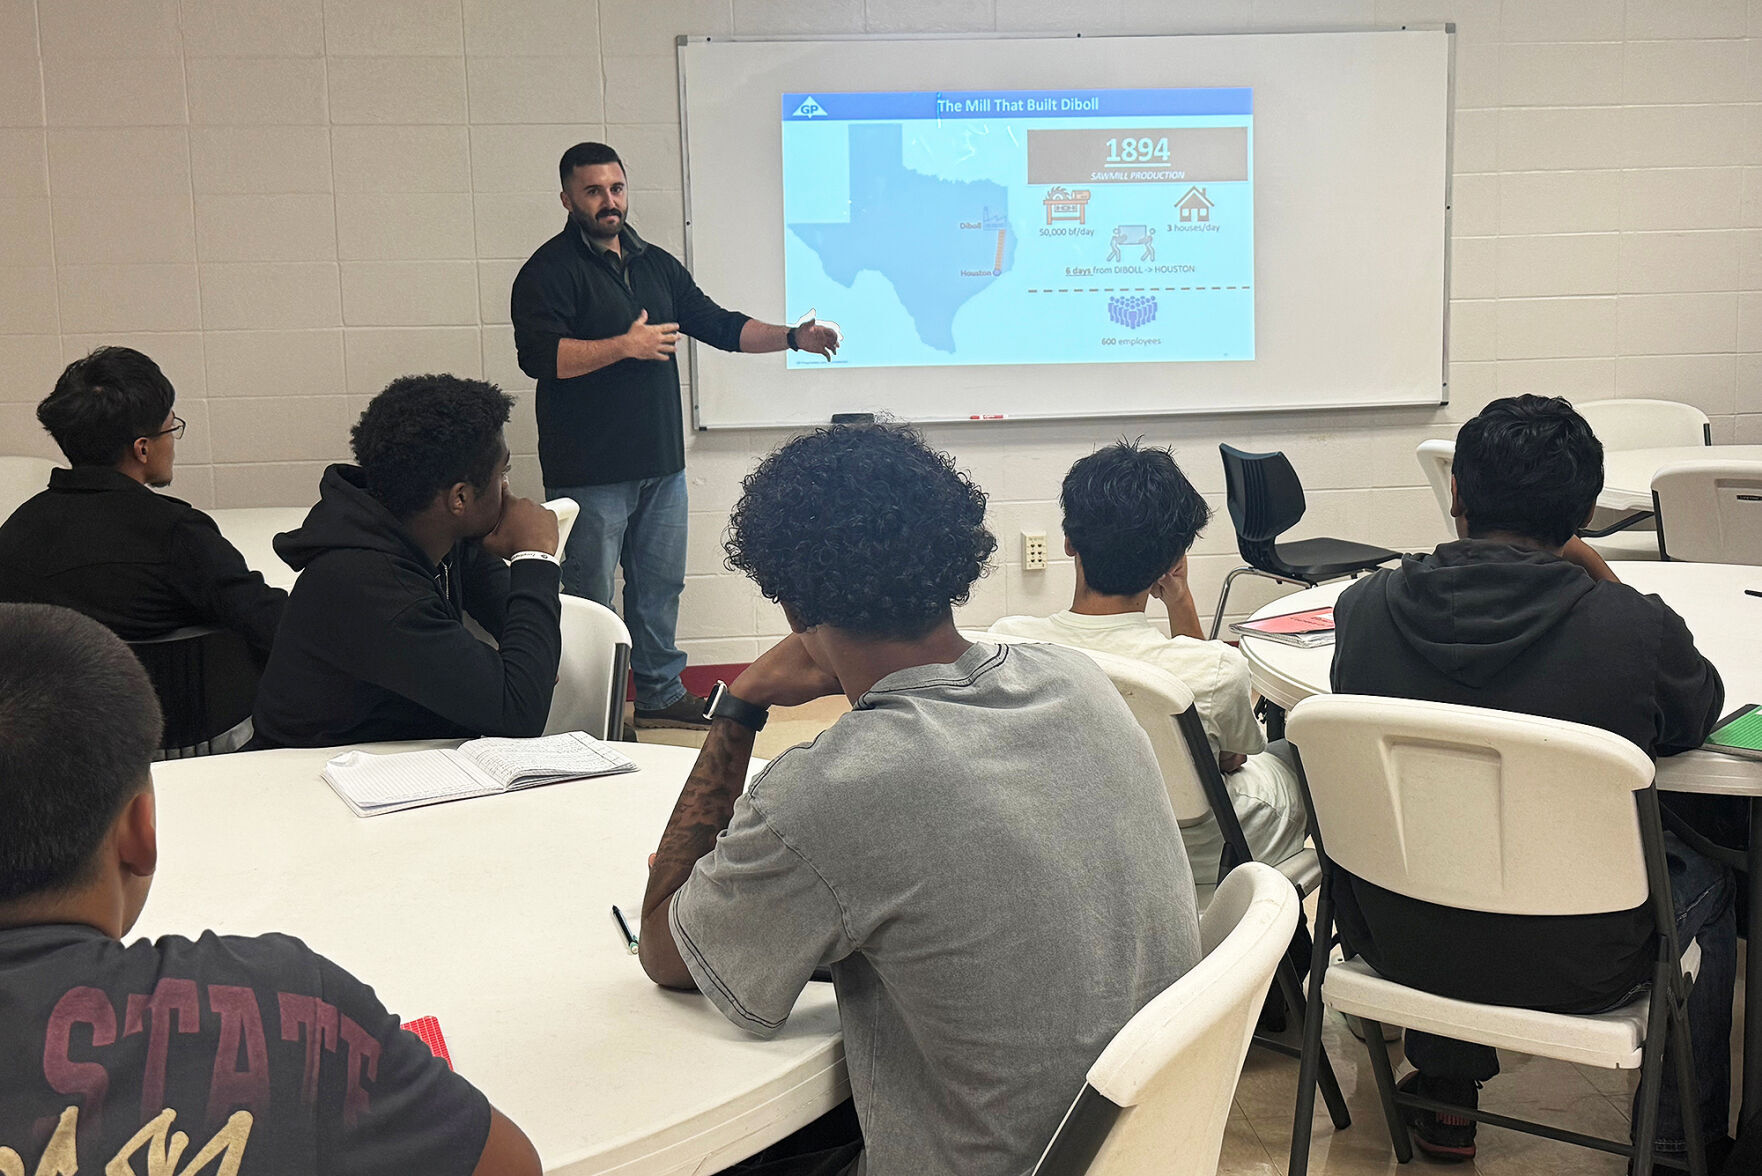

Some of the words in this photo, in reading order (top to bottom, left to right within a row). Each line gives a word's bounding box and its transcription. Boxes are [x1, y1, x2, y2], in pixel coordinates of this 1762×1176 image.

[800, 104, 819, 115] GP
[938, 99, 962, 112] The
[965, 99, 991, 112] Mill
[994, 98, 1024, 112] That
[1027, 98, 1057, 111] Built
[1060, 97, 1099, 111] Diboll
[1105, 137, 1171, 162] 1894
[1090, 171, 1128, 181] SAWMILL
[1130, 170, 1185, 180] PRODUCTION
[959, 222, 981, 230] Diboll
[1167, 224, 1173, 232] 3
[1174, 222, 1220, 234] houses/day
[1039, 228, 1067, 238] 50,000
[1068, 227, 1094, 238] bf/day
[960, 269, 992, 277] Houston
[1072, 266, 1091, 277] days
[1093, 265, 1112, 274] from
[1114, 265, 1143, 274] DIBOLL
[1154, 264, 1196, 273] HOUSTON
[1101, 337, 1117, 346] 600
[1118, 336, 1162, 347] employees
